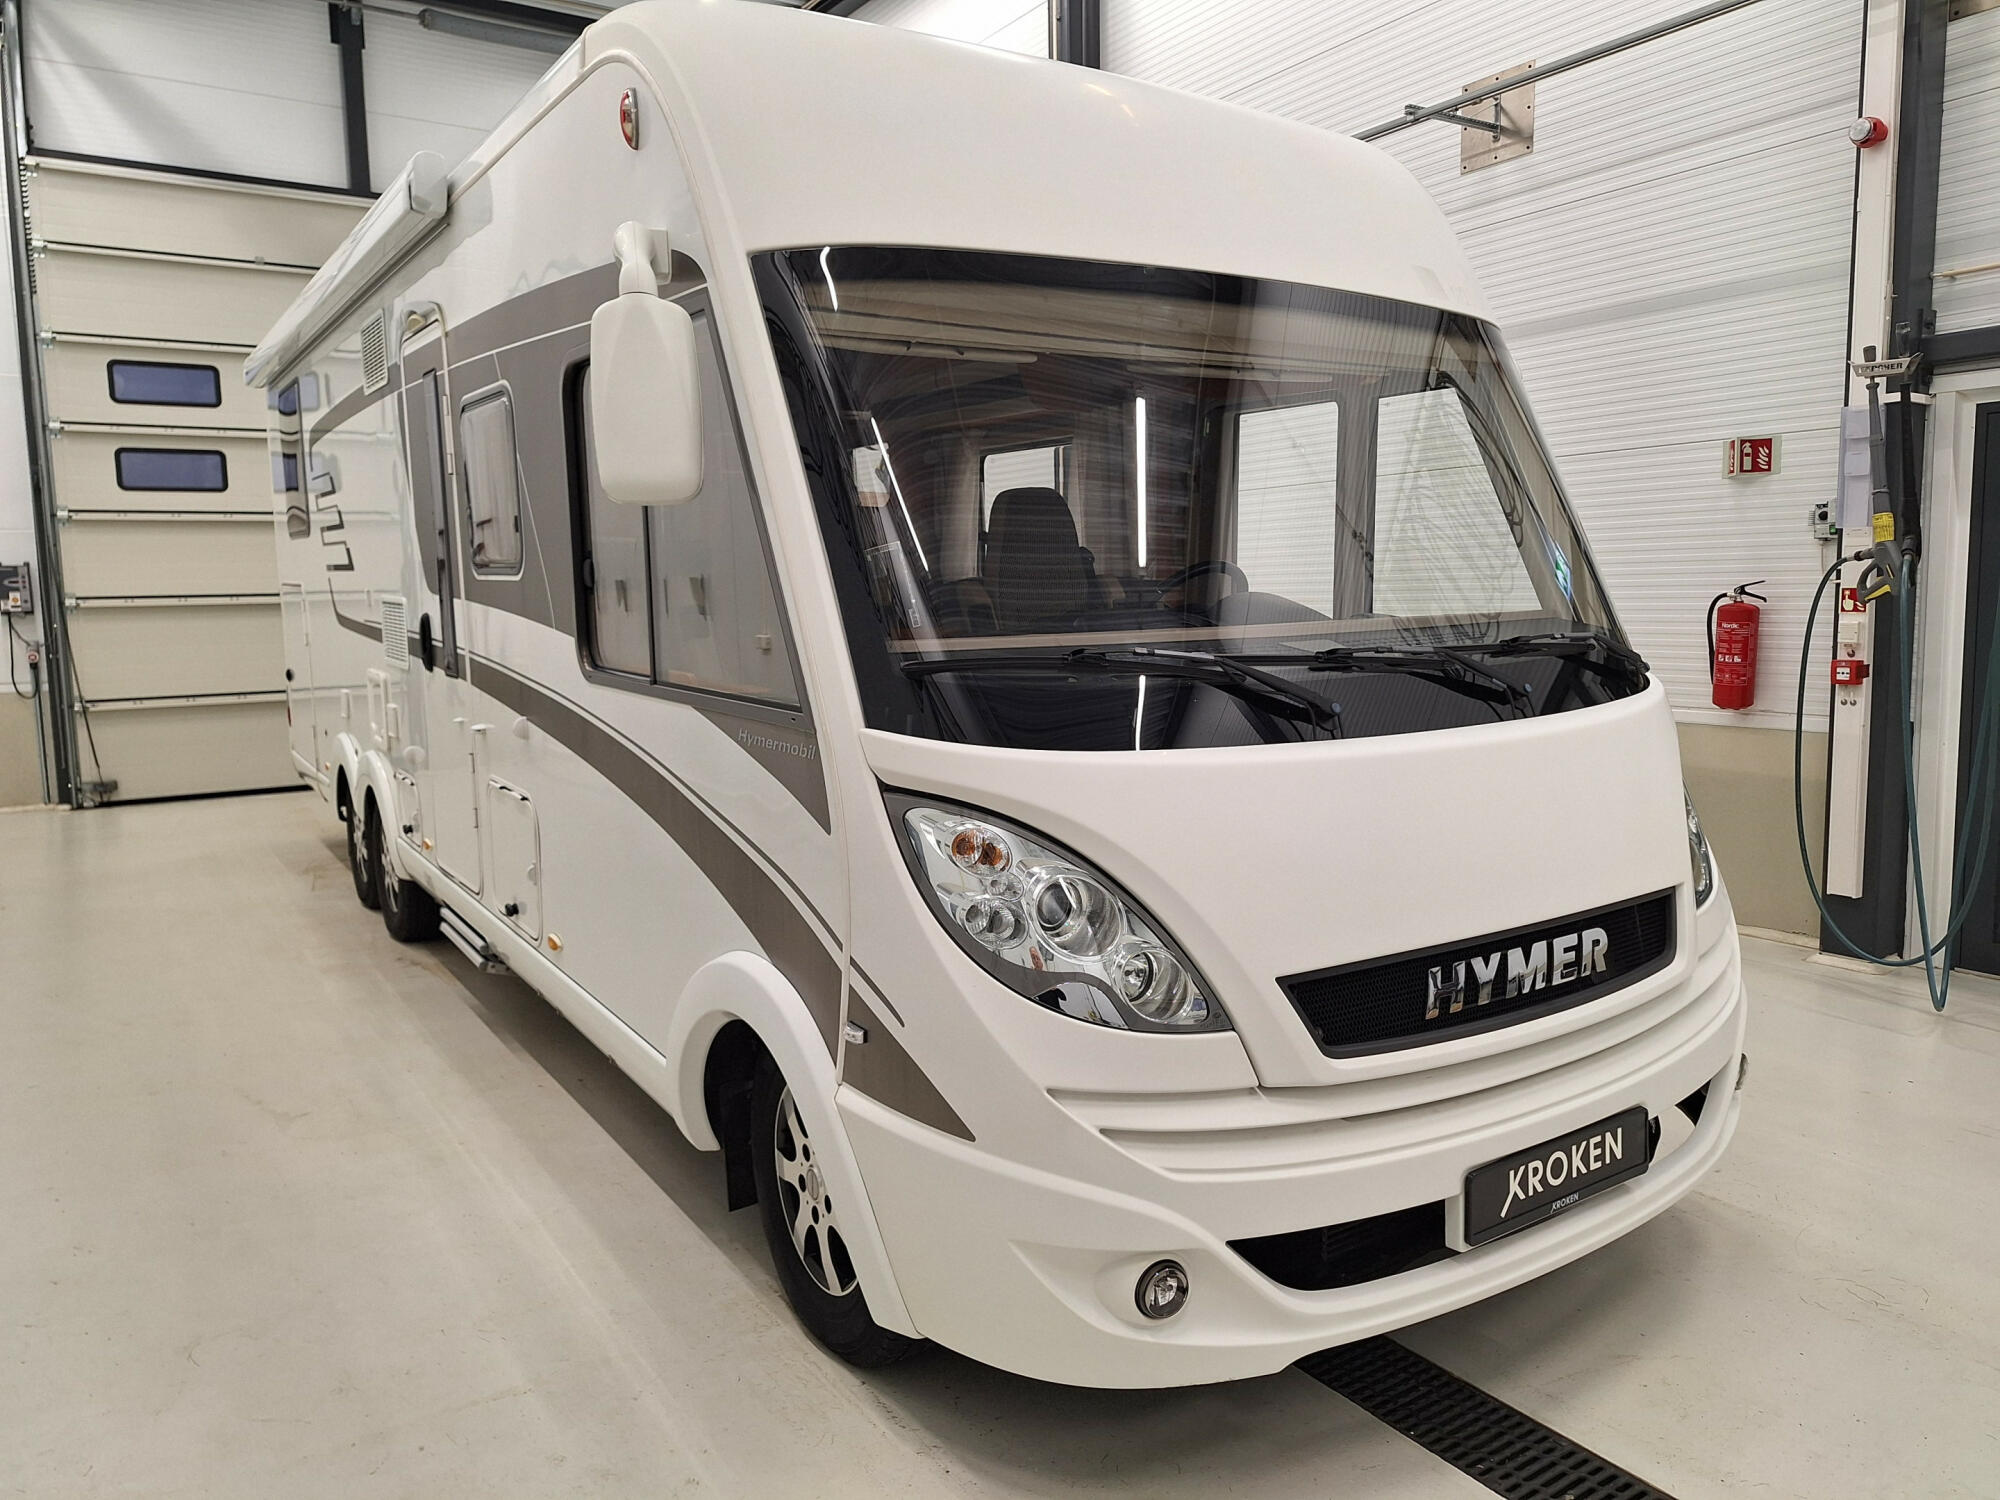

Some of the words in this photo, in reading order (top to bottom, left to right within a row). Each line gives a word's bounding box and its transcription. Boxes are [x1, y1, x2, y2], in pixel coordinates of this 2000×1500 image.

[738, 728, 816, 760] Hymermobil
[1425, 927, 1609, 1020] HYMER
[1500, 1127, 1622, 1218] KROKEN
[1550, 1192, 1579, 1214] KROKEN
